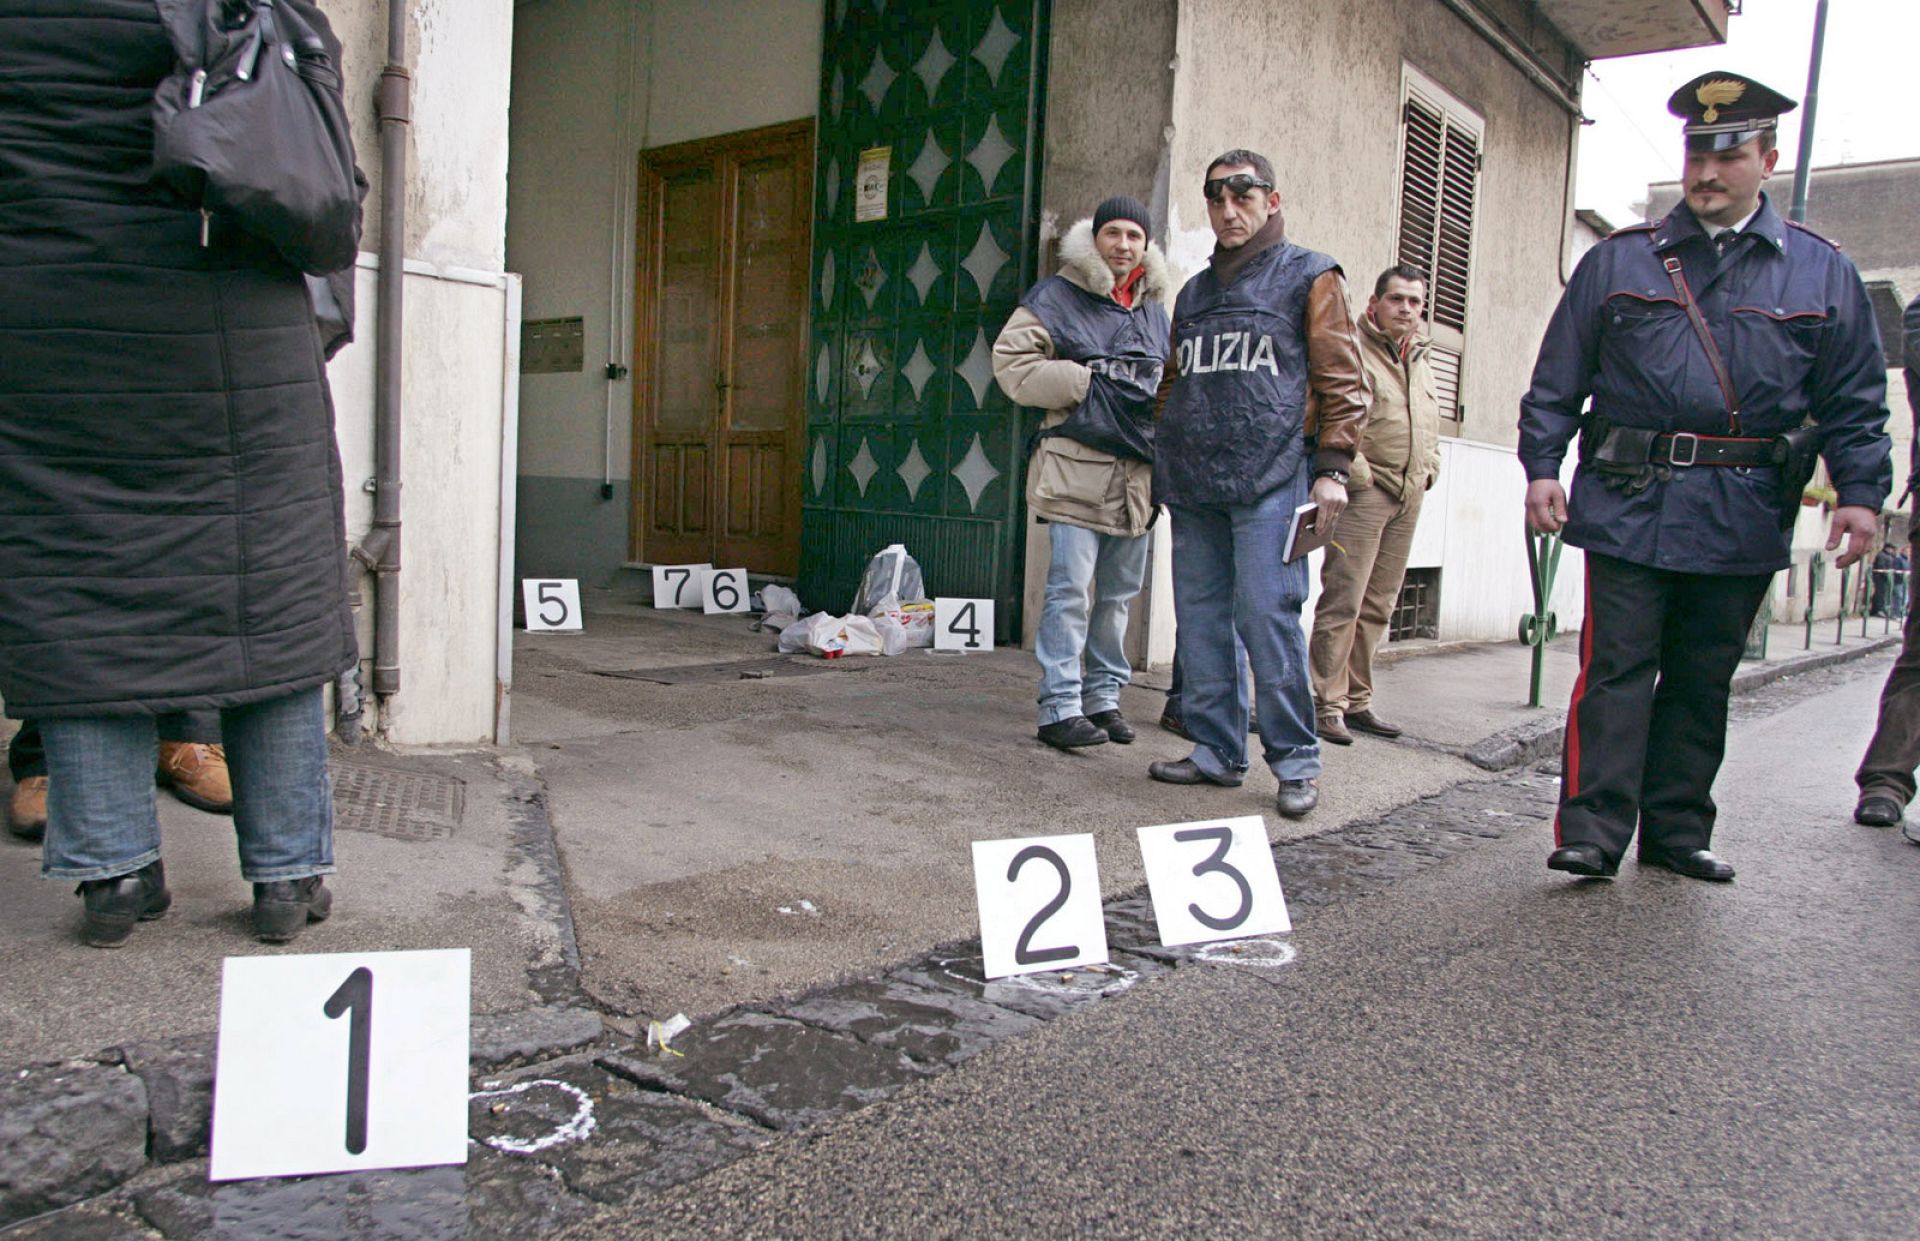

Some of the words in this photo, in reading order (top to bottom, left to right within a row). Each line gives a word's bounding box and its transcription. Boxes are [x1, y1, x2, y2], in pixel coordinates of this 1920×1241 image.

[537, 582, 568, 626] 5
[663, 568, 691, 606] 7
[711, 571, 740, 611] 6
[948, 601, 981, 648] 4
[1173, 826, 1254, 931] 3
[1007, 845, 1080, 966] 2
[323, 966, 373, 1156] 1
